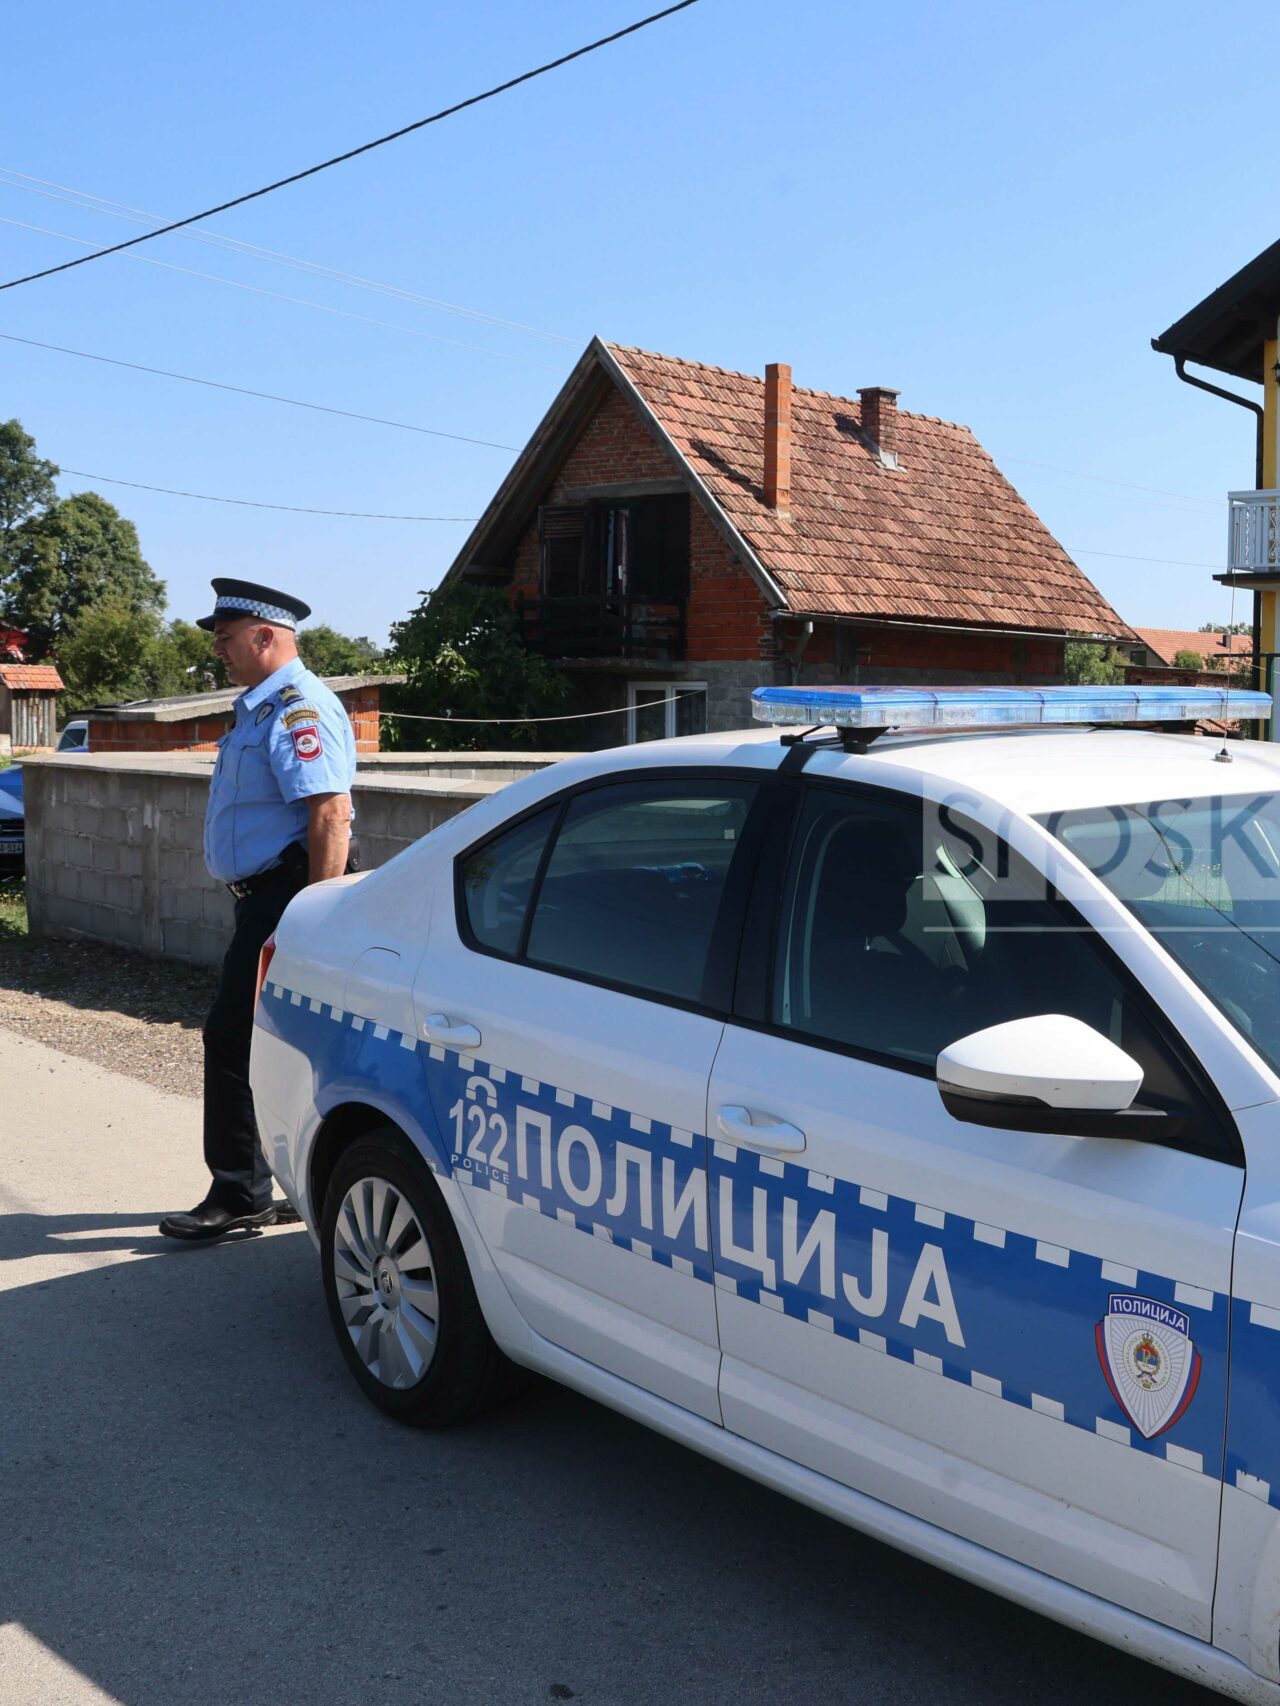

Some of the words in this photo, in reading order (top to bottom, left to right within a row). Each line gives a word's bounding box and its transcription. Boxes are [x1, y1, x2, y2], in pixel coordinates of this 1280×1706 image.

[449, 1098, 509, 1173] 122
[451, 1153, 510, 1185] POLICE
[516, 1104, 966, 1348] ПОЛИЦИЈА
[1113, 1298, 1185, 1332] ПОЛИЦИЈА
